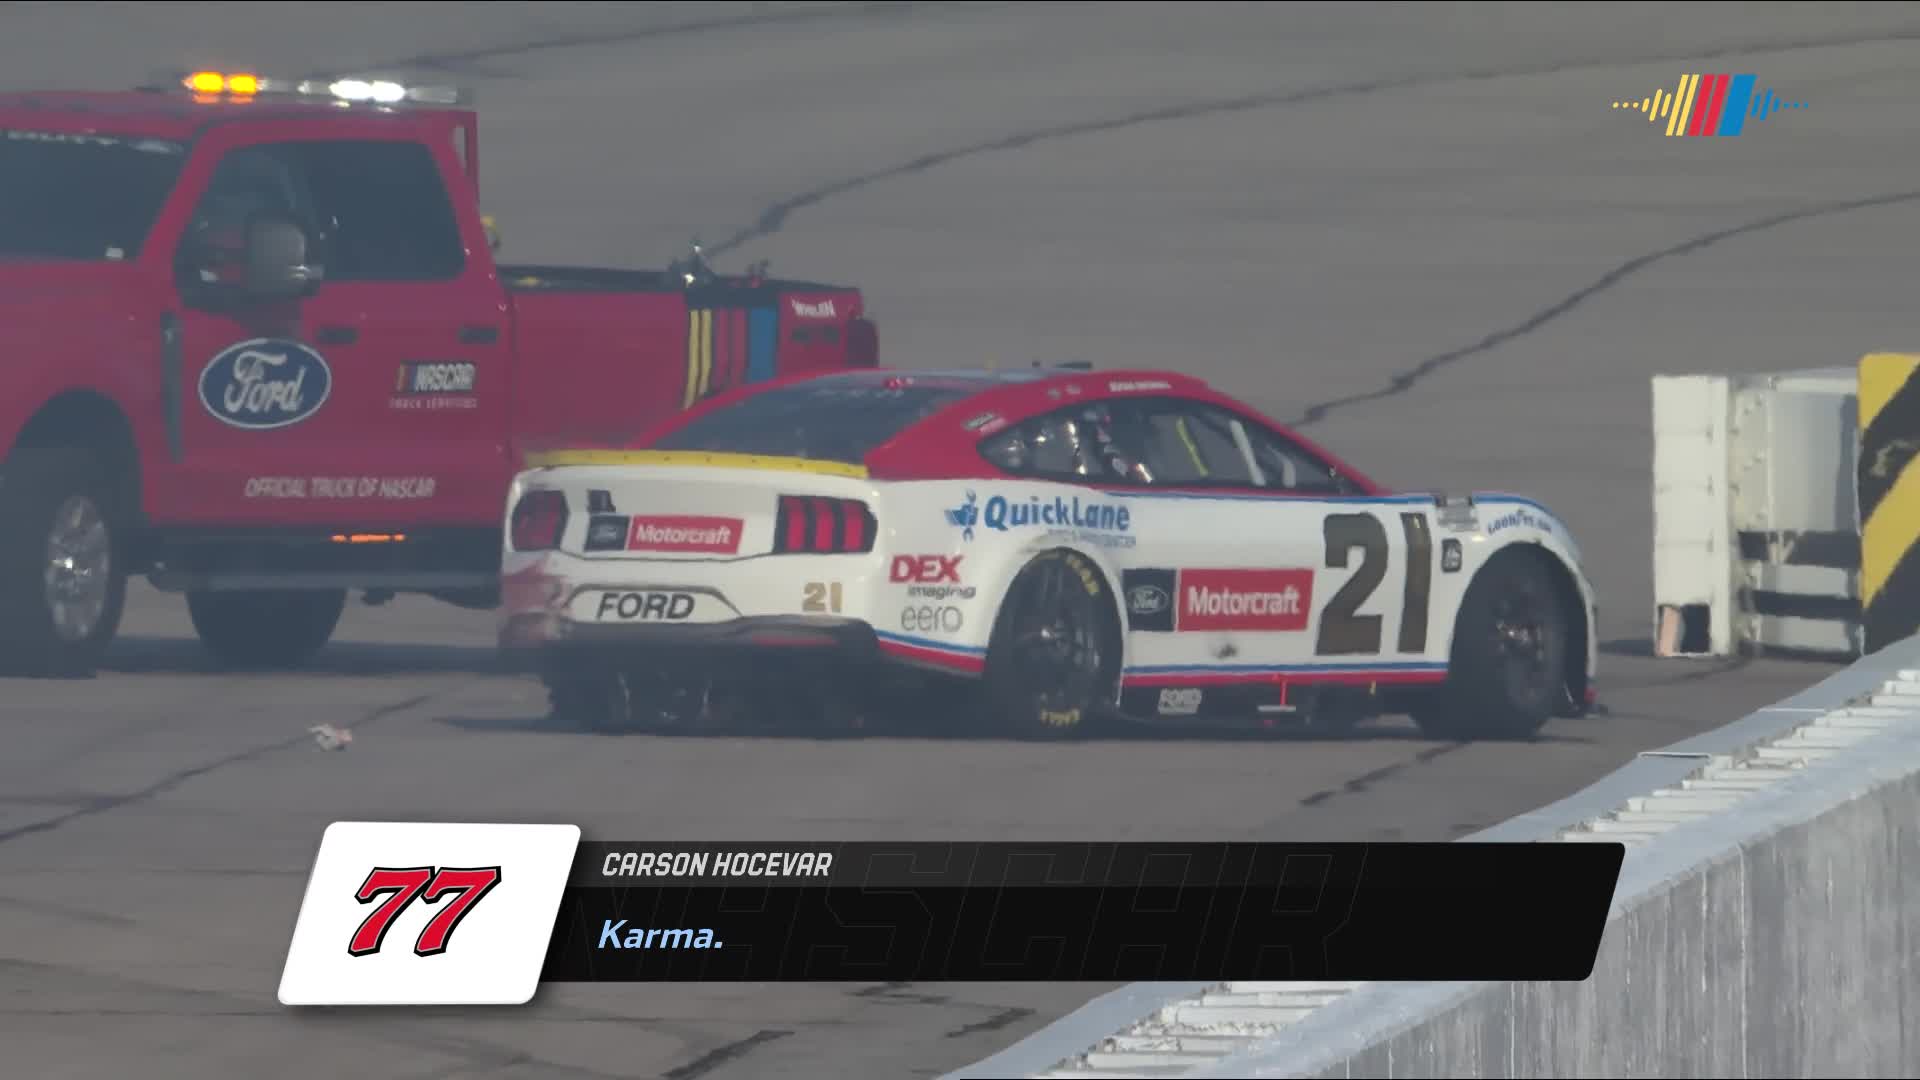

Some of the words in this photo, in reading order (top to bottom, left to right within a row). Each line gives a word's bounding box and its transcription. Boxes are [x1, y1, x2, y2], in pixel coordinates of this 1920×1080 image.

[223, 350, 307, 413] Ford
[414, 363, 475, 391] NASCAR
[244, 477, 306, 498] OFFICIAL
[311, 477, 354, 498] TRUCK
[357, 477, 378, 498] OF
[378, 477, 436, 499] NASCAR
[636, 523, 732, 545] Motorcraft
[889, 554, 963, 582] DEX
[802, 582, 843, 612] 21
[907, 585, 977, 600] imaging
[1313, 511, 1432, 656] 21
[597, 592, 695, 620] FORD
[1188, 585, 1300, 616] Motorcraft
[901, 605, 963, 631] eero
